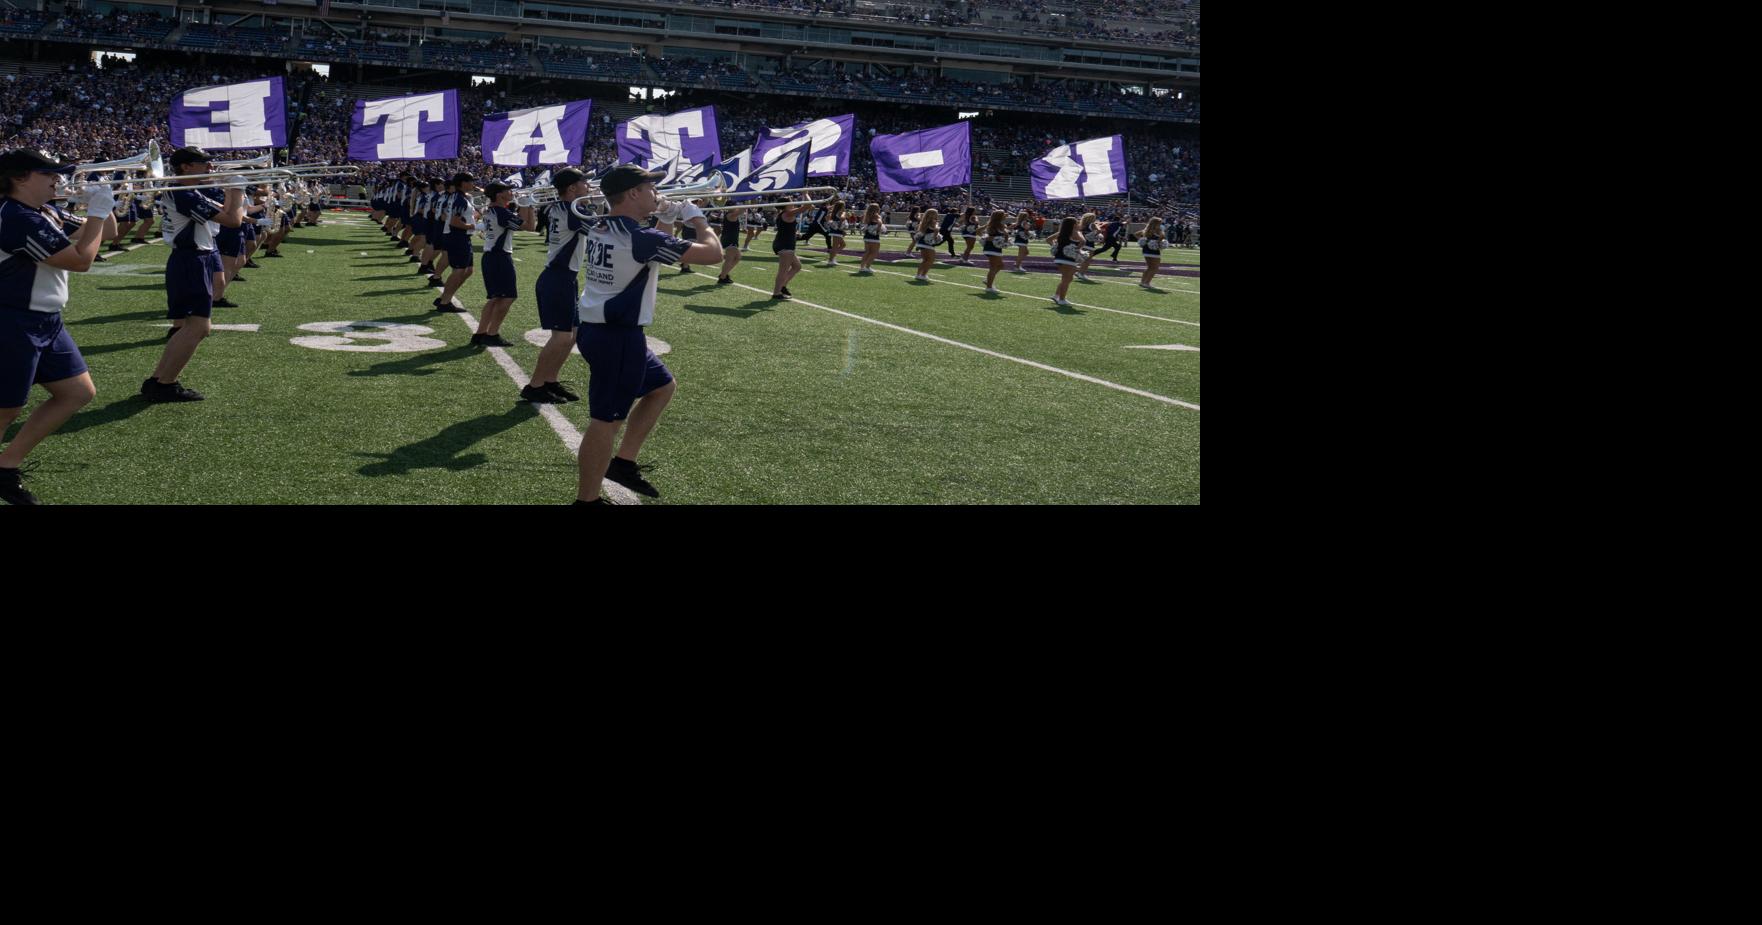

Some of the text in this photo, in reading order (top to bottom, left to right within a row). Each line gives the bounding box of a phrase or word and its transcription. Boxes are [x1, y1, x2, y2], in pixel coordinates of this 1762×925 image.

[363, 92, 444, 160] T
[492, 104, 570, 166] A
[626, 109, 704, 172] T
